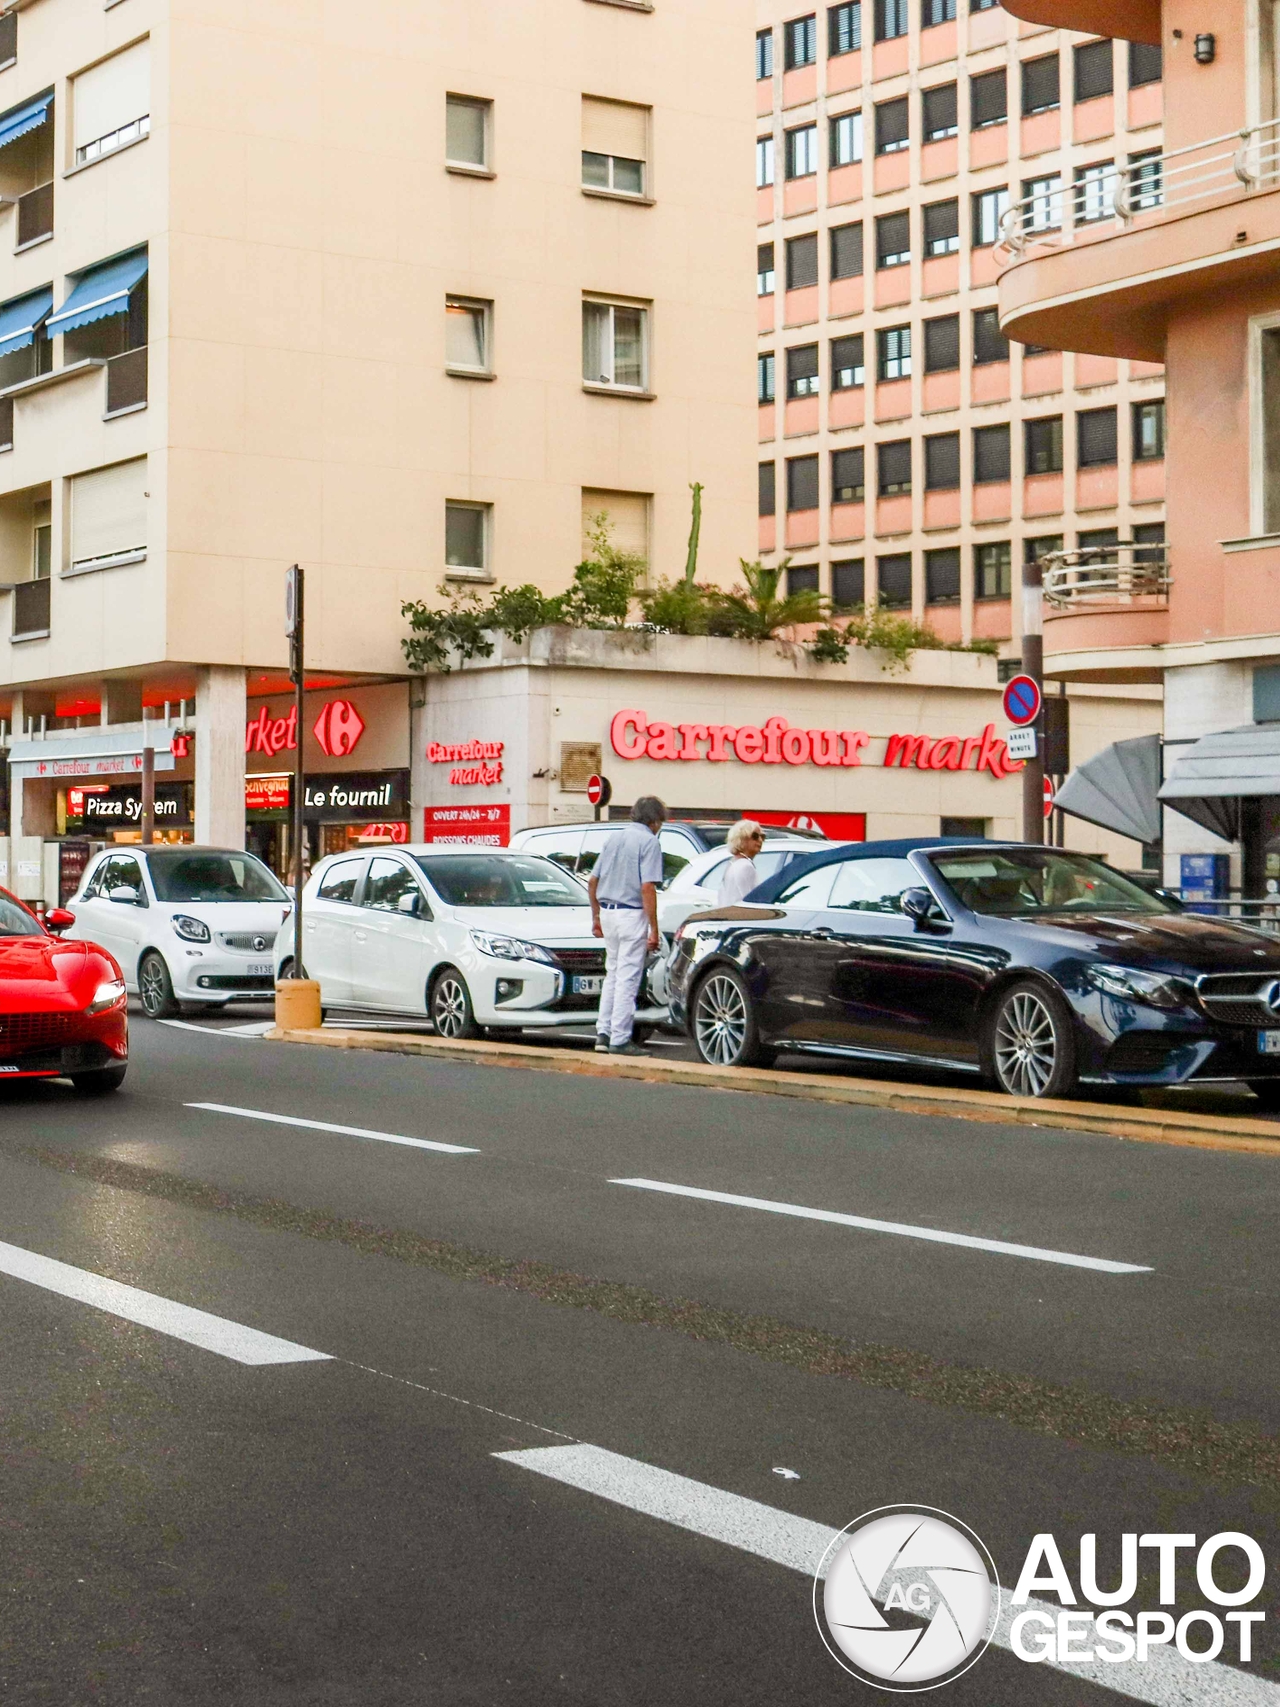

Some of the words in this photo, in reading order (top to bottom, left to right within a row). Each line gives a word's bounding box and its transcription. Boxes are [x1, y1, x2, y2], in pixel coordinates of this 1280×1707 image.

[246, 705, 297, 757] rket
[426, 739, 504, 764] Carrefour
[610, 708, 869, 767] Carrefour
[883, 723, 1026, 780] marke
[52, 759, 91, 775] Carrefour
[96, 758, 125, 773] market
[448, 761, 504, 787] market
[304, 787, 325, 807] Le
[329, 783, 391, 806] fournil
[87, 797, 122, 815] Pizza
[125, 797, 177, 820] Syem
[433, 810, 458, 821] OUVERT
[467, 835, 501, 846] CHAUDES
